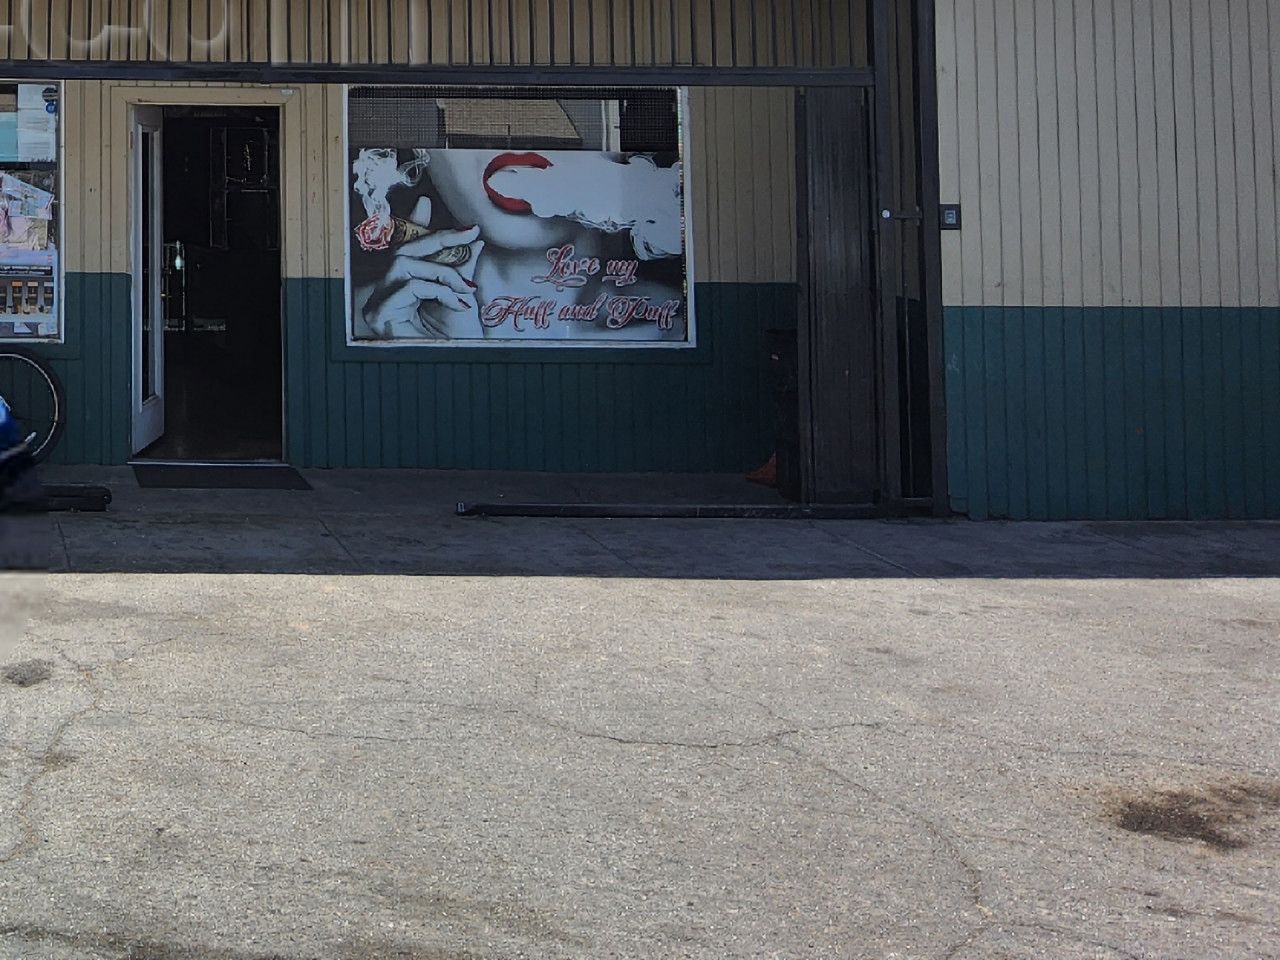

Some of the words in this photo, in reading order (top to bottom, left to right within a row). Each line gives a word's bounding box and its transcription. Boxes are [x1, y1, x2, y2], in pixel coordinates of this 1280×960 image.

[531, 244, 601, 291] Love
[602, 259, 639, 287] my
[482, 295, 556, 332] Huff
[558, 292, 609, 322] and
[606, 295, 680, 330] Puff
